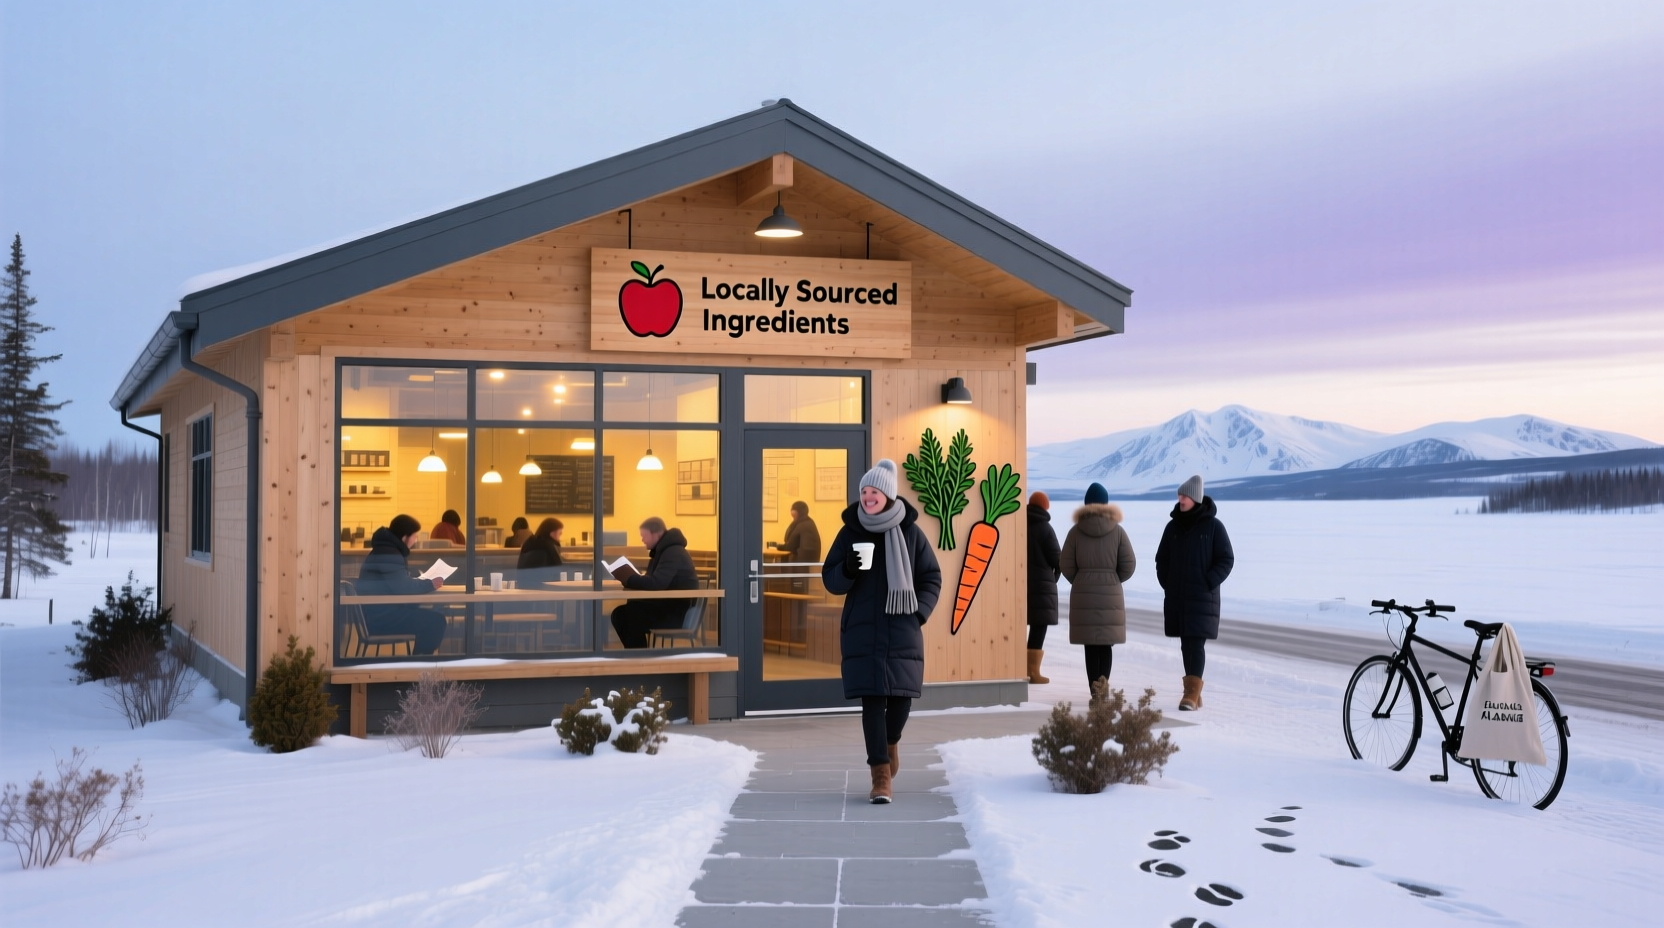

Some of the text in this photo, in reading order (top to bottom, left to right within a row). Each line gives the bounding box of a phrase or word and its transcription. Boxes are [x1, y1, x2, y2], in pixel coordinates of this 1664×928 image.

[701, 277, 898, 307] Locally Sourced
[703, 309, 850, 338] Ingredients
